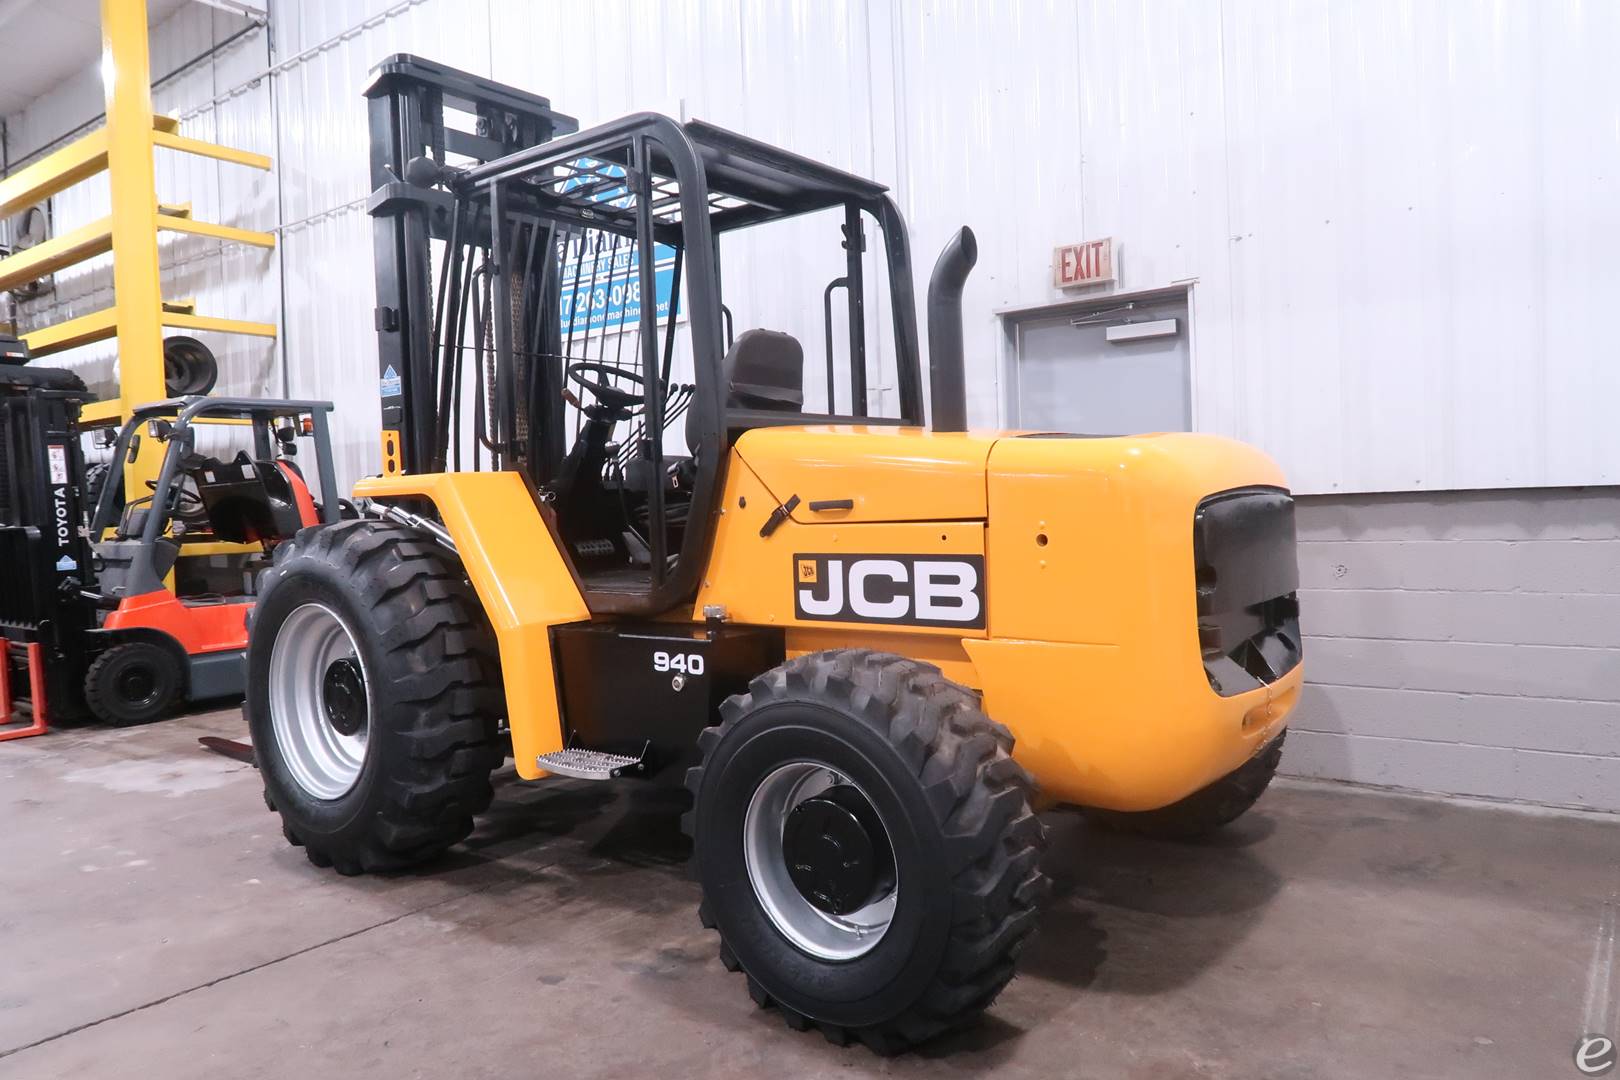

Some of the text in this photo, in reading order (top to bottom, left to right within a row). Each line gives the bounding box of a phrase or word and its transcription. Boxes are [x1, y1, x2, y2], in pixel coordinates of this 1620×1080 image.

[1061, 242, 1104, 283] EXIT
[54, 487, 70, 547] TOYOTA
[799, 559, 980, 621] JCB
[653, 651, 705, 675] 940
